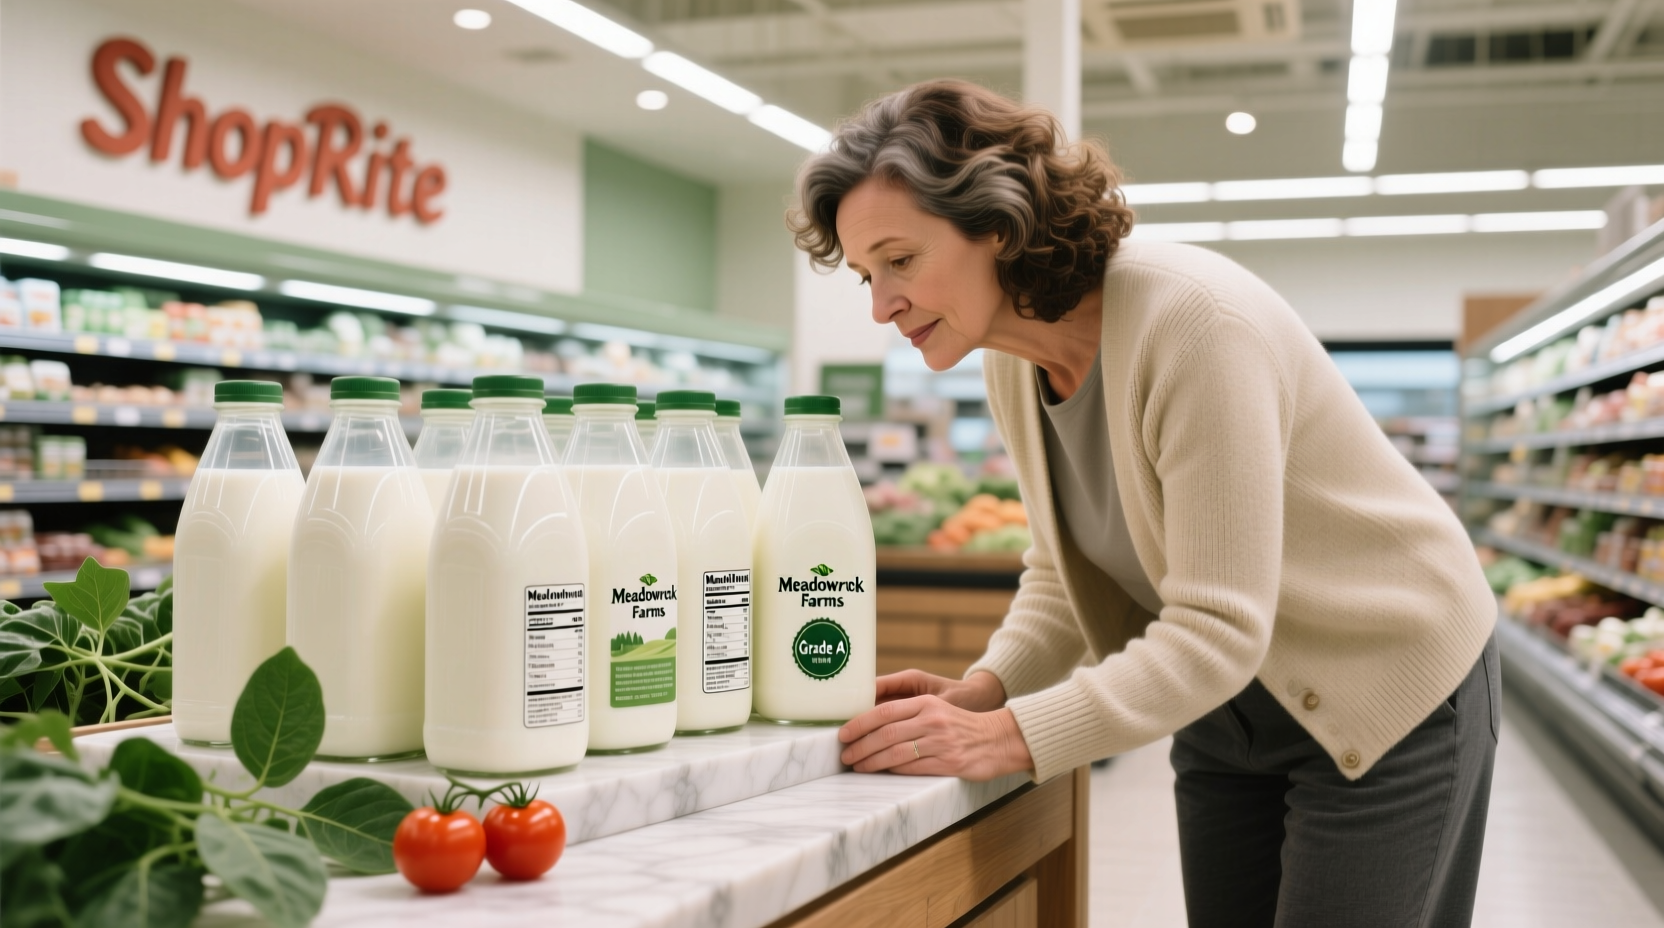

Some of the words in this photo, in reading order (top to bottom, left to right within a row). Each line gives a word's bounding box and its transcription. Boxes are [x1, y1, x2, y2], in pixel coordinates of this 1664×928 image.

[80, 36, 446, 224] ShopRite
[801, 593, 844, 607] Farms
[632, 605, 665, 619] Farms
[799, 640, 833, 655] Grade
[836, 641, 845, 655] A
